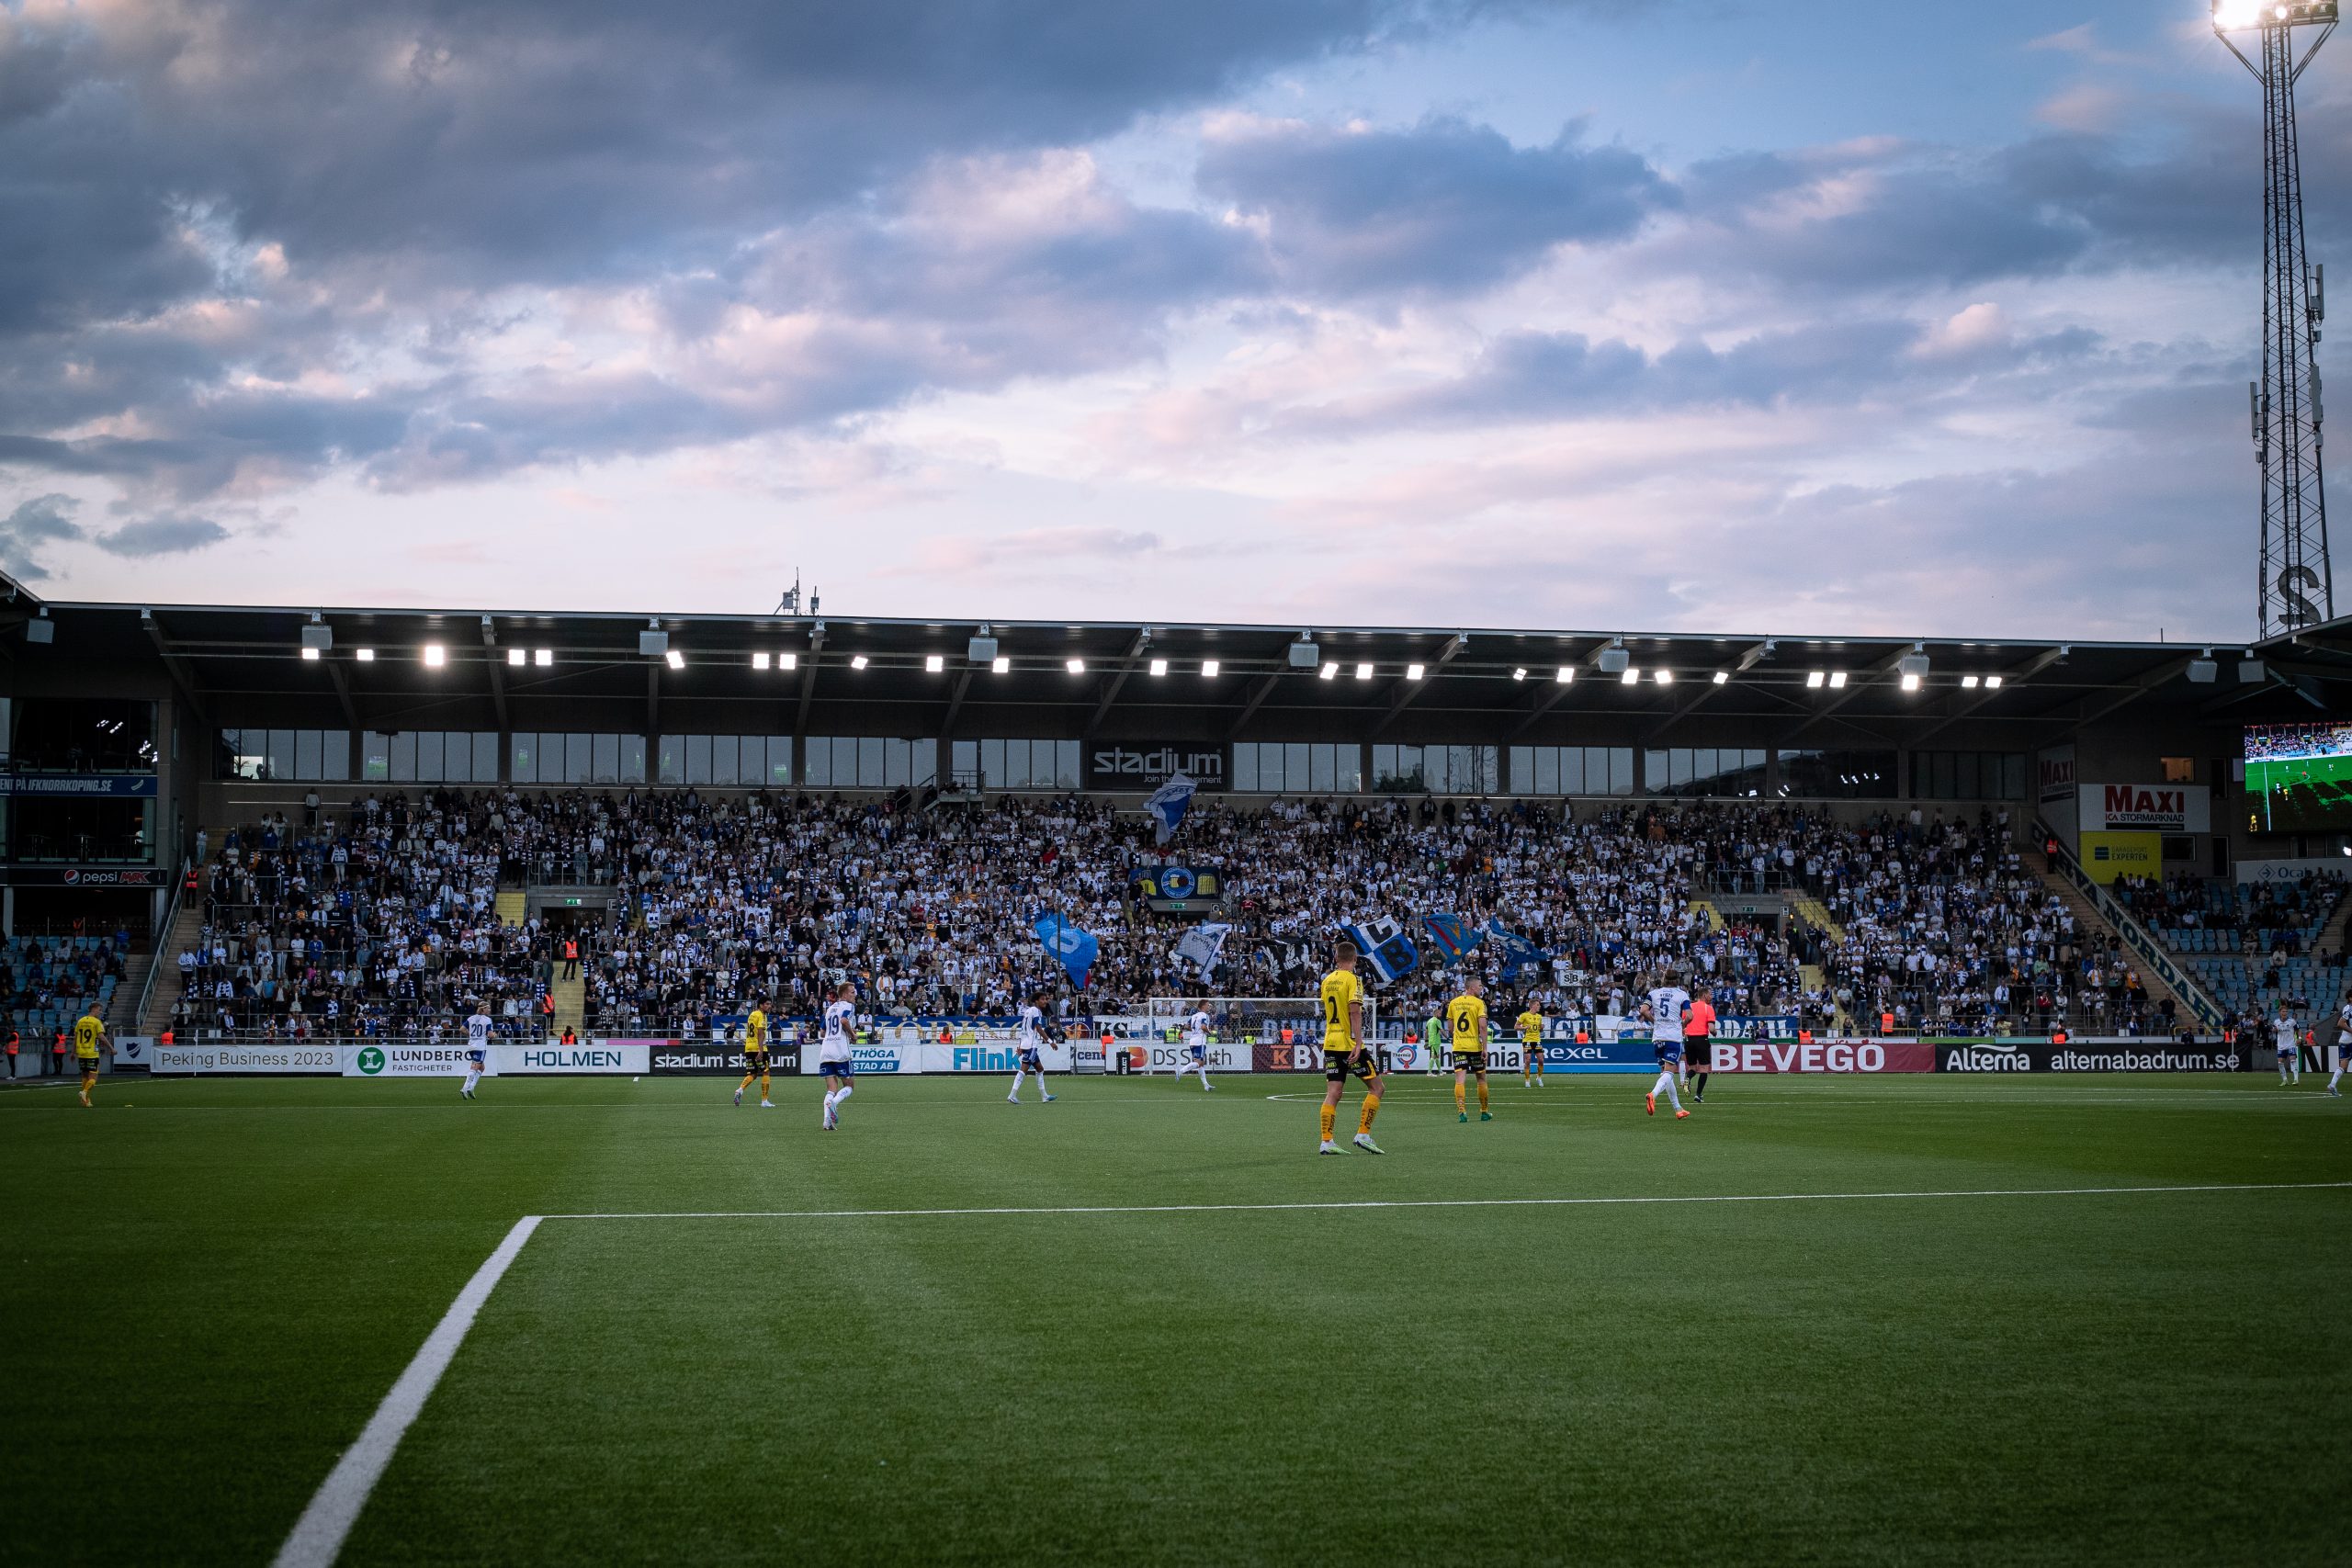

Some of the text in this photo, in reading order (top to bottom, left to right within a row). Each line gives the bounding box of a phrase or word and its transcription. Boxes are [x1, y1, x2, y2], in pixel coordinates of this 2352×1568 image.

[1094, 747, 1222, 774] stadium
[1145, 774, 1160, 784] Join
[1192, 776, 1222, 784] vement
[2041, 760, 2074, 786] MAXI
[16, 776, 27, 791] PÅ
[2105, 785, 2185, 813] MAXI
[2120, 814, 2185, 822] STORMARKNAD
[83, 872, 118, 885] pepsi
[1659, 998, 1670, 1018] 5
[828, 1014, 840, 1036] 19
[1457, 1012, 1470, 1032] 6
[78, 1029, 92, 1043] 19
[470, 1023, 483, 1037] 20
[162, 1052, 334, 1068] Peking Business 2023
[525, 1051, 622, 1066] HOLMEN
[654, 1053, 723, 1068] stadium
[852, 1048, 896, 1058] THÖGA
[1154, 1049, 1177, 1066] DS
[1712, 1044, 1885, 1071] BEVEGO
[1947, 1044, 2240, 1071] Alterna alternabadrum.se
[854, 1062, 895, 1070] STAD AB
